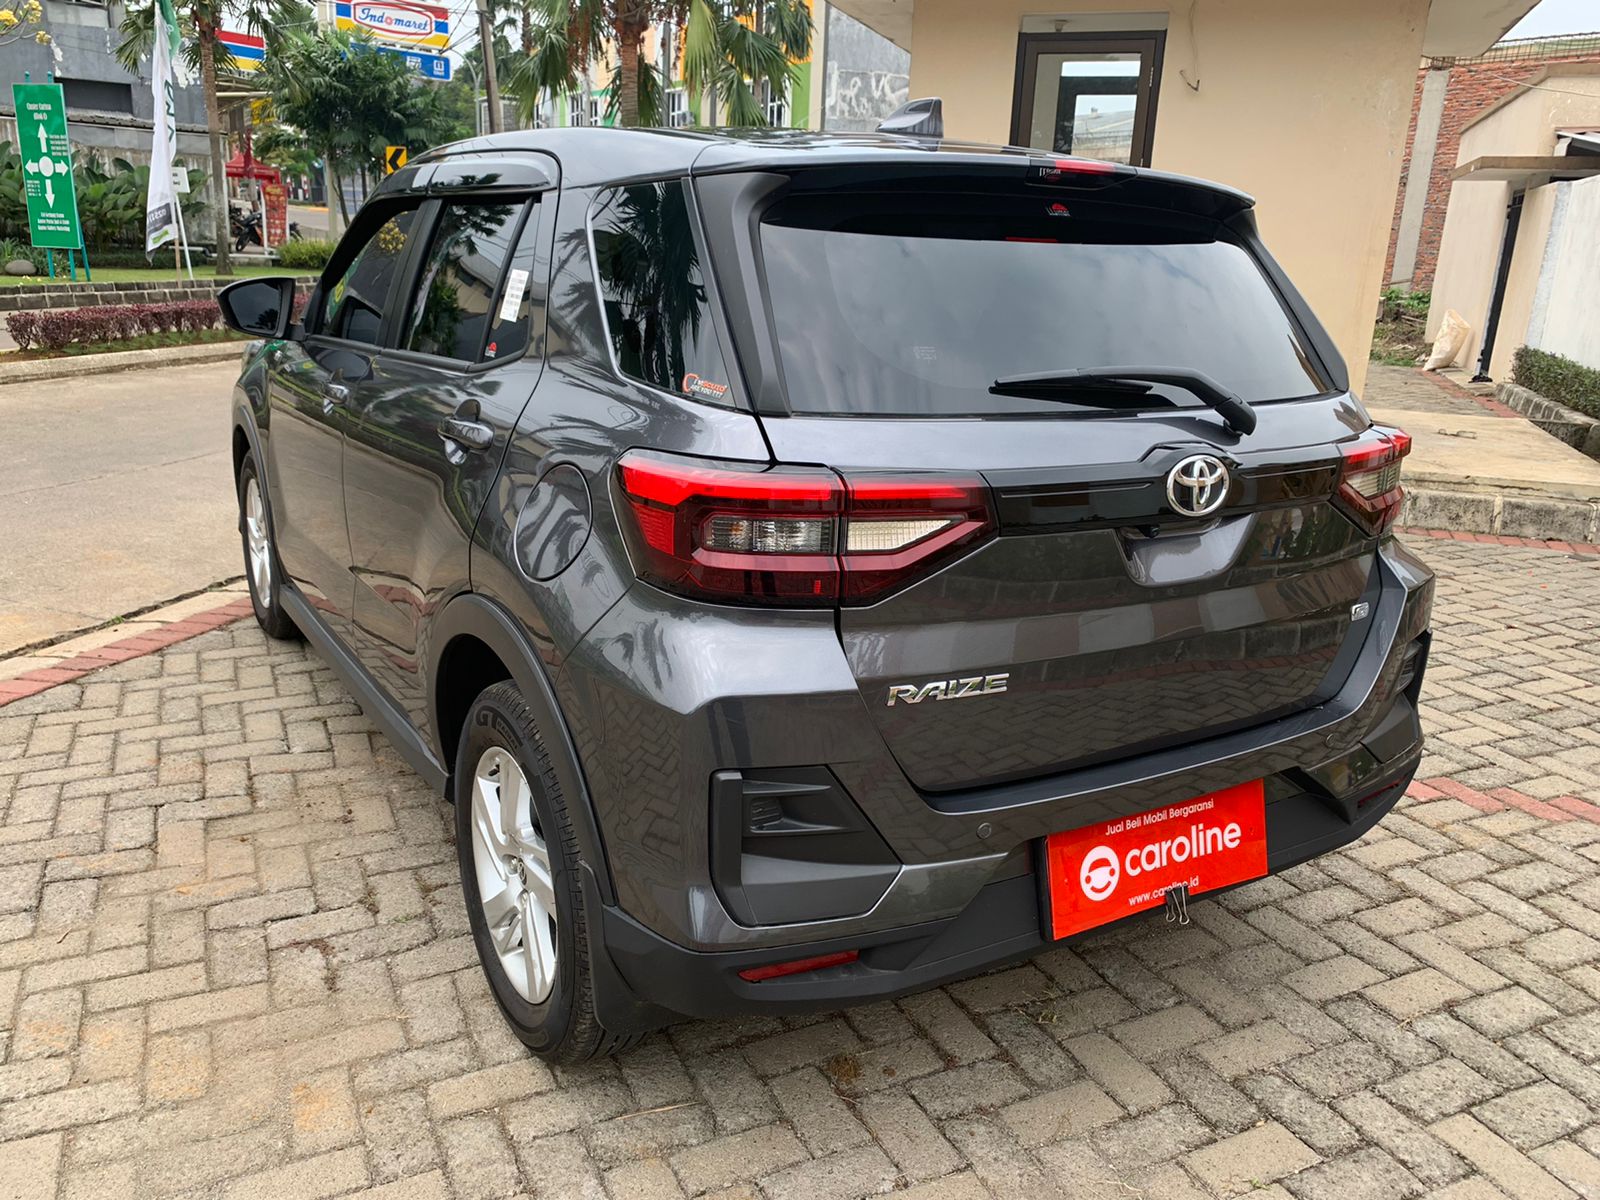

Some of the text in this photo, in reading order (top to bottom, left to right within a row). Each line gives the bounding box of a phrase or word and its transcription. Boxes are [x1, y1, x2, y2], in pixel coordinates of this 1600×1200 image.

[358, 7, 429, 31] Indomaret
[887, 673, 1009, 707] RAIZE
[1105, 798, 1215, 836] Jual Beli Mobil Bergaransi
[1125, 822, 1242, 877] caroline
